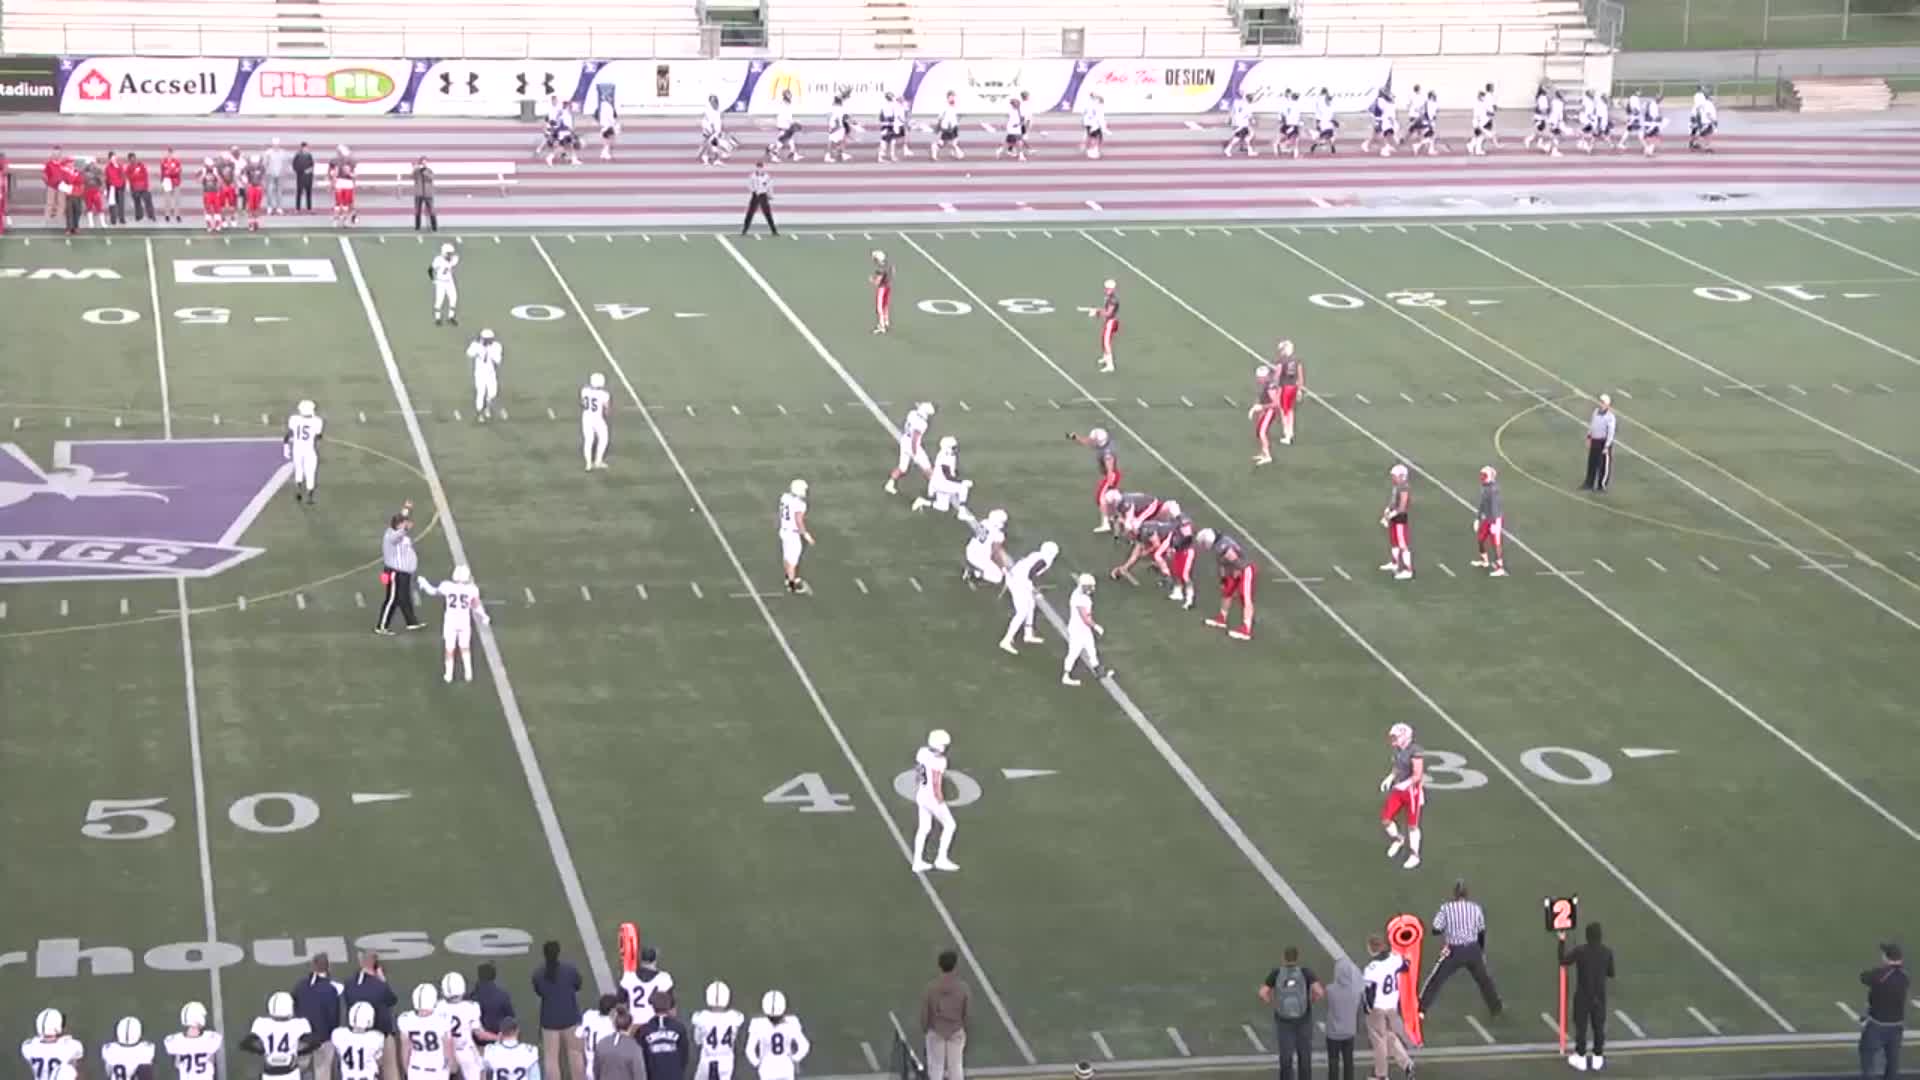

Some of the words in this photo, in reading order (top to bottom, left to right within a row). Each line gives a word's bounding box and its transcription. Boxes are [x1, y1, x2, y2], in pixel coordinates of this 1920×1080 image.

[119, 72, 216, 94] Accsell
[1164, 68, 1215, 86] DESIGN
[296, 424, 311, 441] 15
[448, 593, 470, 609] 25
[1552, 898, 1573, 930] 2
[266, 1033, 290, 1053] 14
[408, 1031, 440, 1052] 58
[706, 1026, 733, 1050] 44
[771, 1033, 784, 1056] 8
[179, 1052, 207, 1074] 75
[342, 1045, 364, 1071] 41
